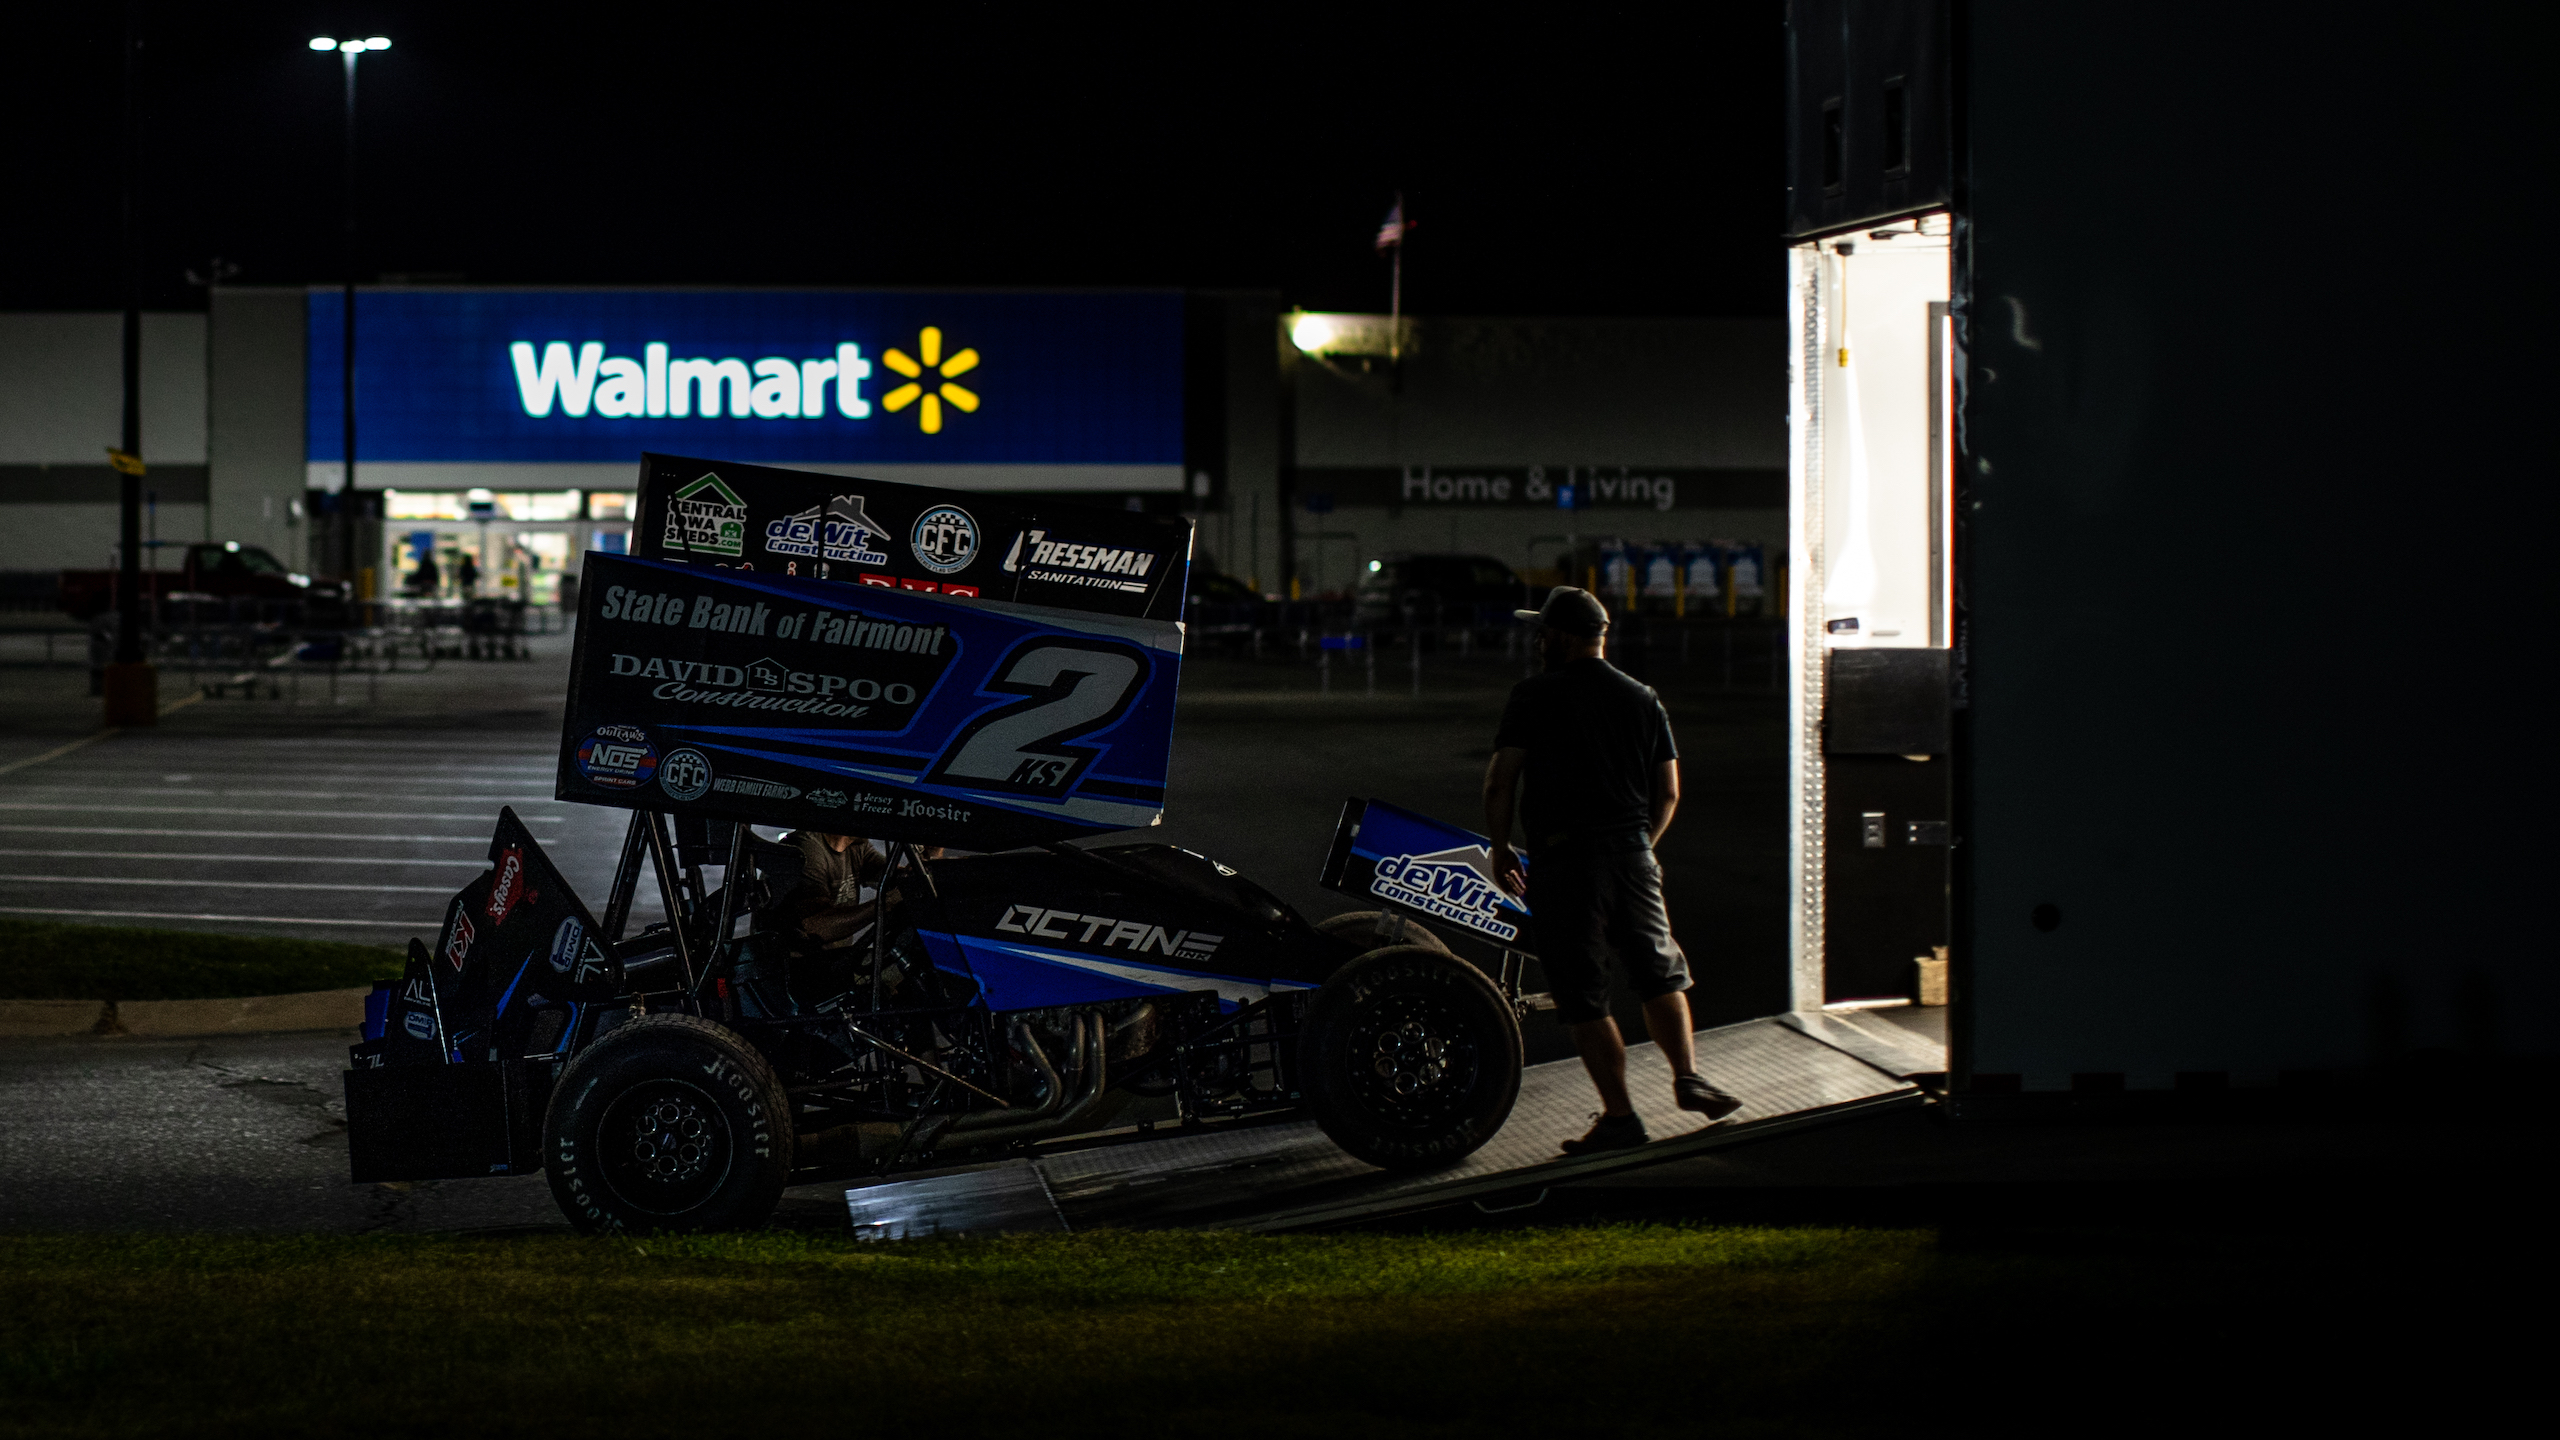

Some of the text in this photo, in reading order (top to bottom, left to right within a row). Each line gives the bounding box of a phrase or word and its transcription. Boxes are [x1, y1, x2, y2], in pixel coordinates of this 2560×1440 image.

[509, 341, 873, 420] Walmart
[1402, 465, 1513, 500] Home
[1525, 464, 1552, 500] &
[668, 513, 716, 531] IOWA
[766, 517, 870, 549] deWit
[920, 523, 971, 556] CFC
[1002, 529, 1156, 578] CRESSMAN
[1027, 569, 1124, 591] SANITATION
[601, 585, 946, 656] State Bank of Fairmont
[610, 653, 745, 688] DAVID
[786, 671, 917, 705] SPOO
[652, 681, 871, 720] Construction
[944, 646, 1139, 787] 2
[588, 743, 649, 771] NOS
[667, 762, 706, 788] CFC
[1014, 757, 1067, 787] KS
[713, 777, 738, 793] WEBB
[735, 780, 765, 797] FAMILY
[762, 783, 789, 800] FARMS
[861, 802, 893, 815] Freeze
[897, 799, 972, 823] Hoosier
[489, 855, 521, 917] Casey's
[1376, 856, 1502, 914] deWit
[1372, 880, 1518, 940] Construction
[994, 904, 1226, 956] OCTANE
